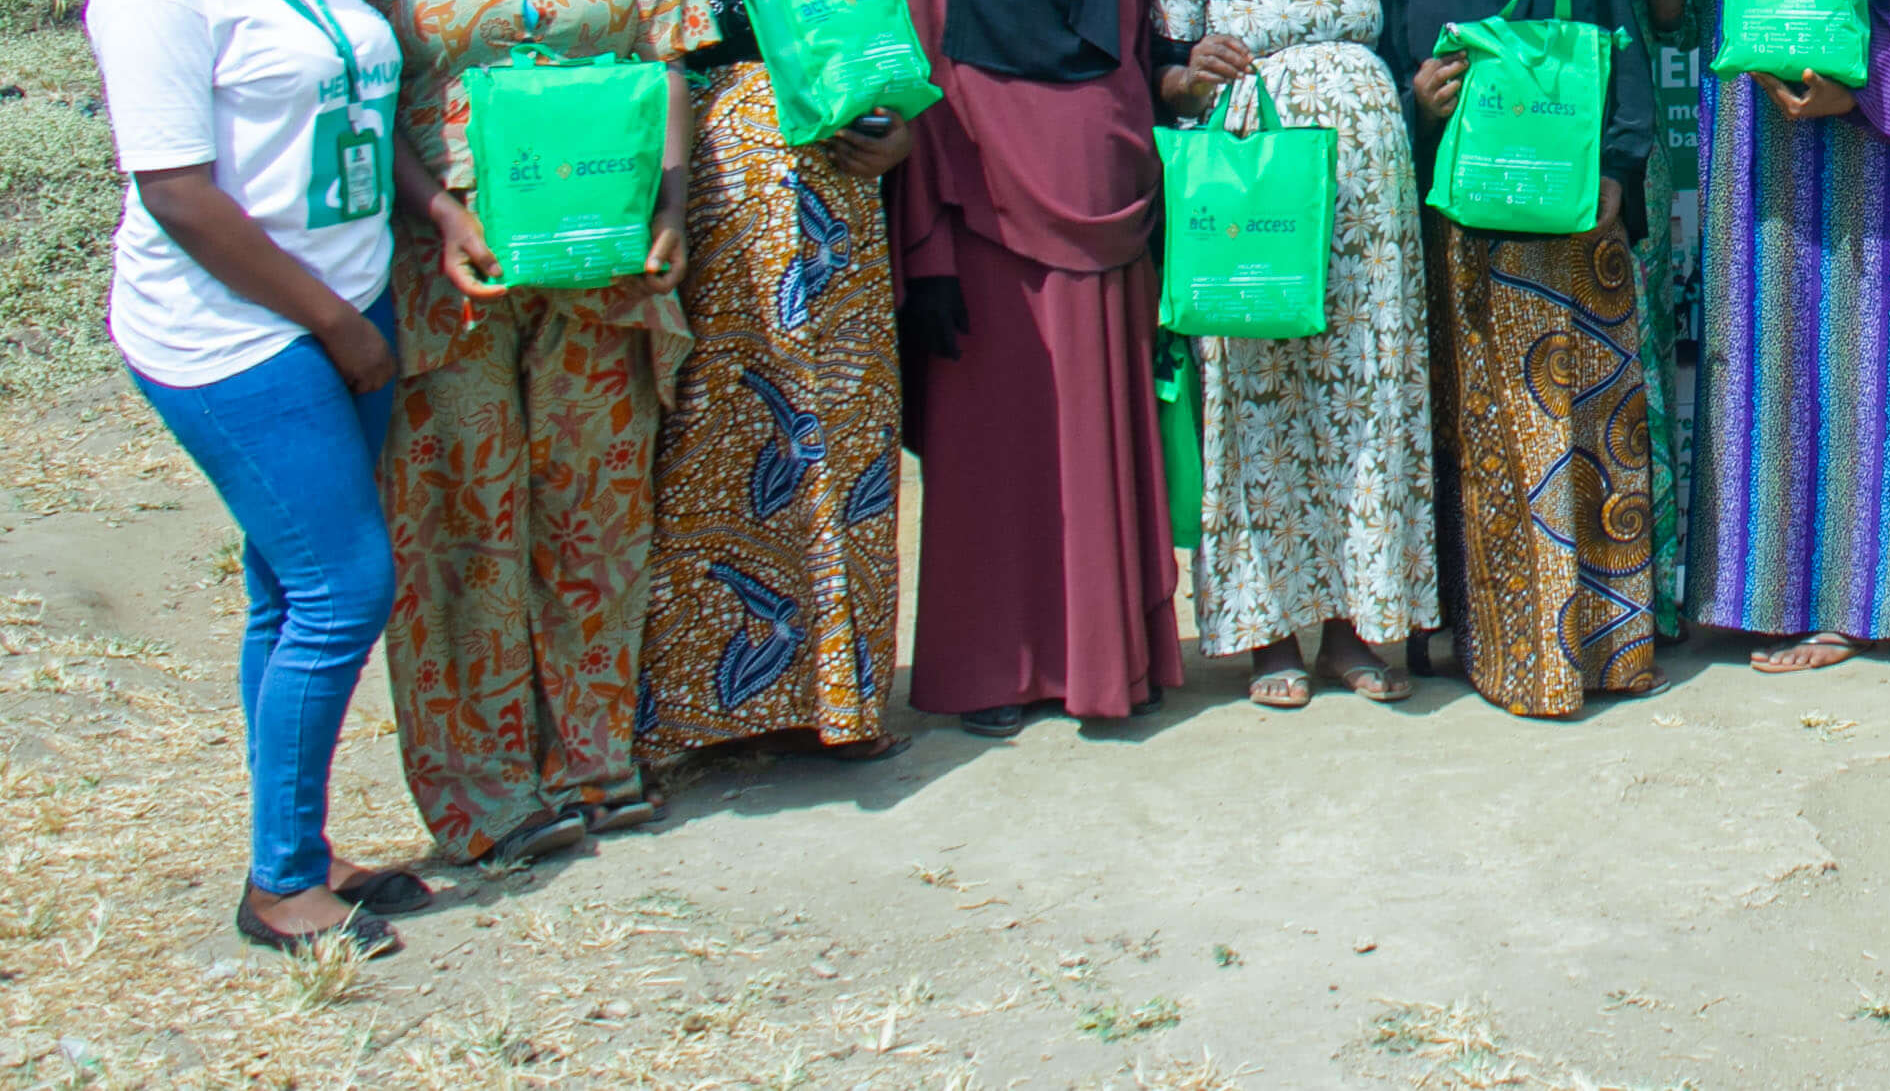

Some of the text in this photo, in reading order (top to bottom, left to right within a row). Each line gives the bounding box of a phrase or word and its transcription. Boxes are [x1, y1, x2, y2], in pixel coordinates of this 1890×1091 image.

[1478, 93, 1576, 117] act access
[509, 158, 636, 182] act access
[1189, 214, 1297, 233] act access
